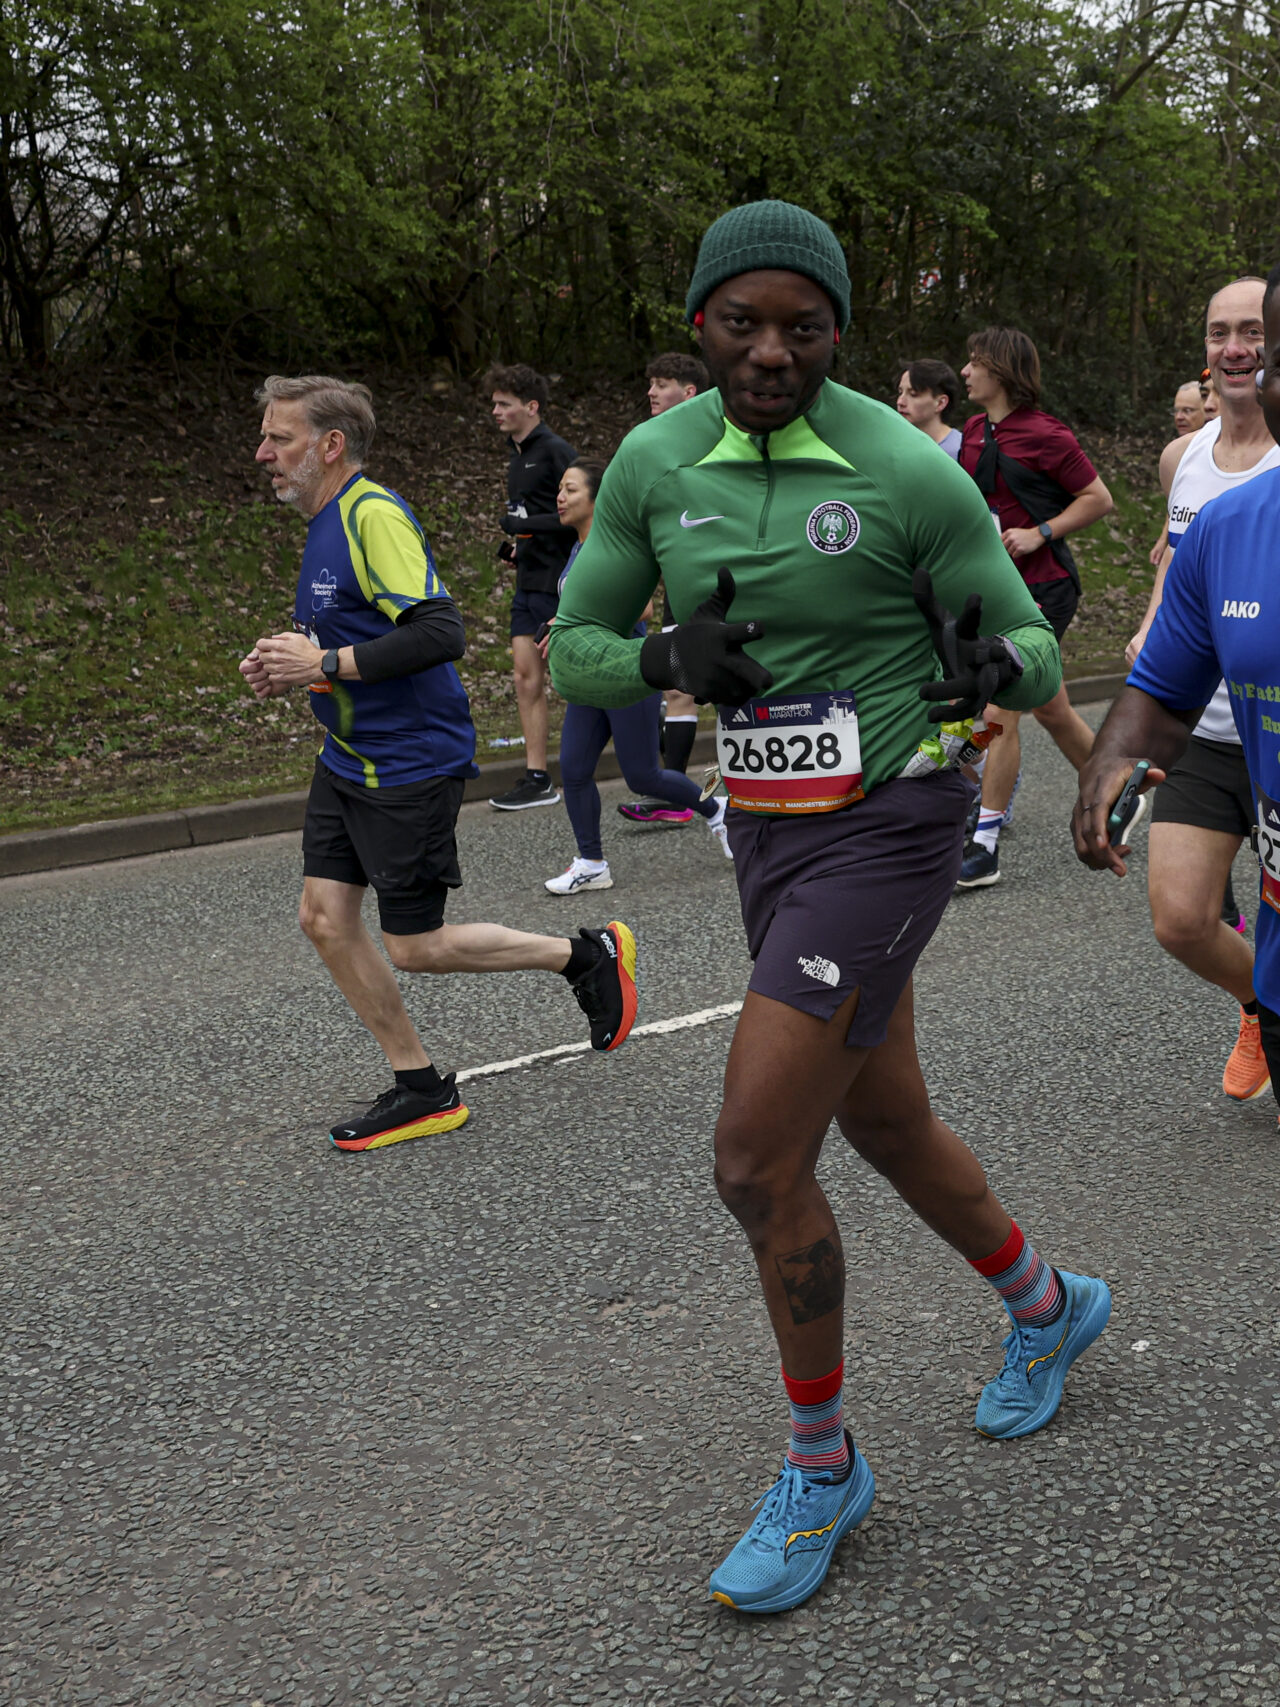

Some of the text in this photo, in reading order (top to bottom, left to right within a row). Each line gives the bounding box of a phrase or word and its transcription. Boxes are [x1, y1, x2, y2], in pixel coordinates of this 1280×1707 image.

[814, 504, 844, 519] FOOTBALL
[843, 509, 857, 546] FEDERATION
[314, 589, 332, 597] Society
[1221, 600, 1261, 619] JAKO
[768, 703, 812, 712] MANCHESTER
[769, 708, 813, 720] MARATHON
[722, 732, 842, 774] 26828
[797, 956, 829, 974] NORTH
[814, 954, 831, 967] THE
[802, 966, 825, 981] FACE
